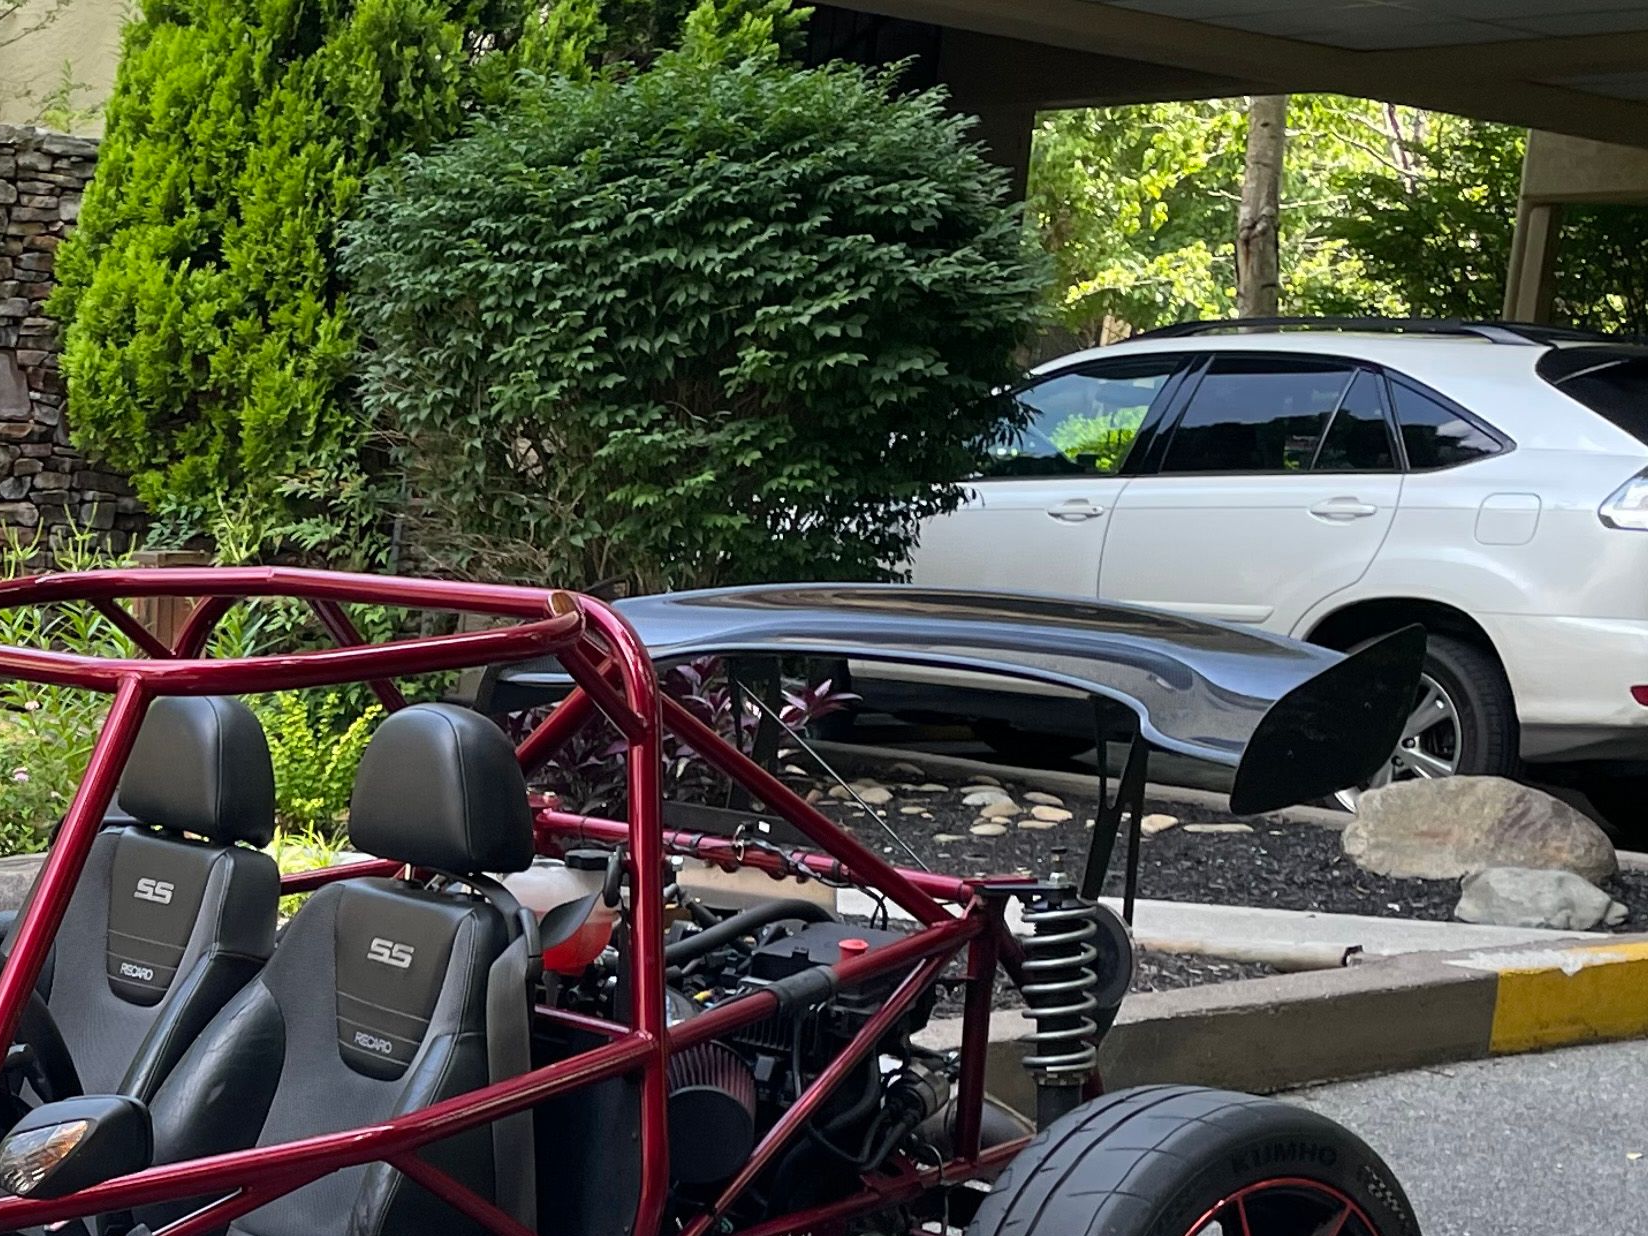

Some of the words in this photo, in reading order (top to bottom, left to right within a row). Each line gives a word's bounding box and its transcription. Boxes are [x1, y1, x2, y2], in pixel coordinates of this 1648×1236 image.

[134, 878, 175, 905] SS
[367, 937, 415, 969] SS
[120, 962, 154, 981] RECARO
[354, 1031, 393, 1054] RECARO
